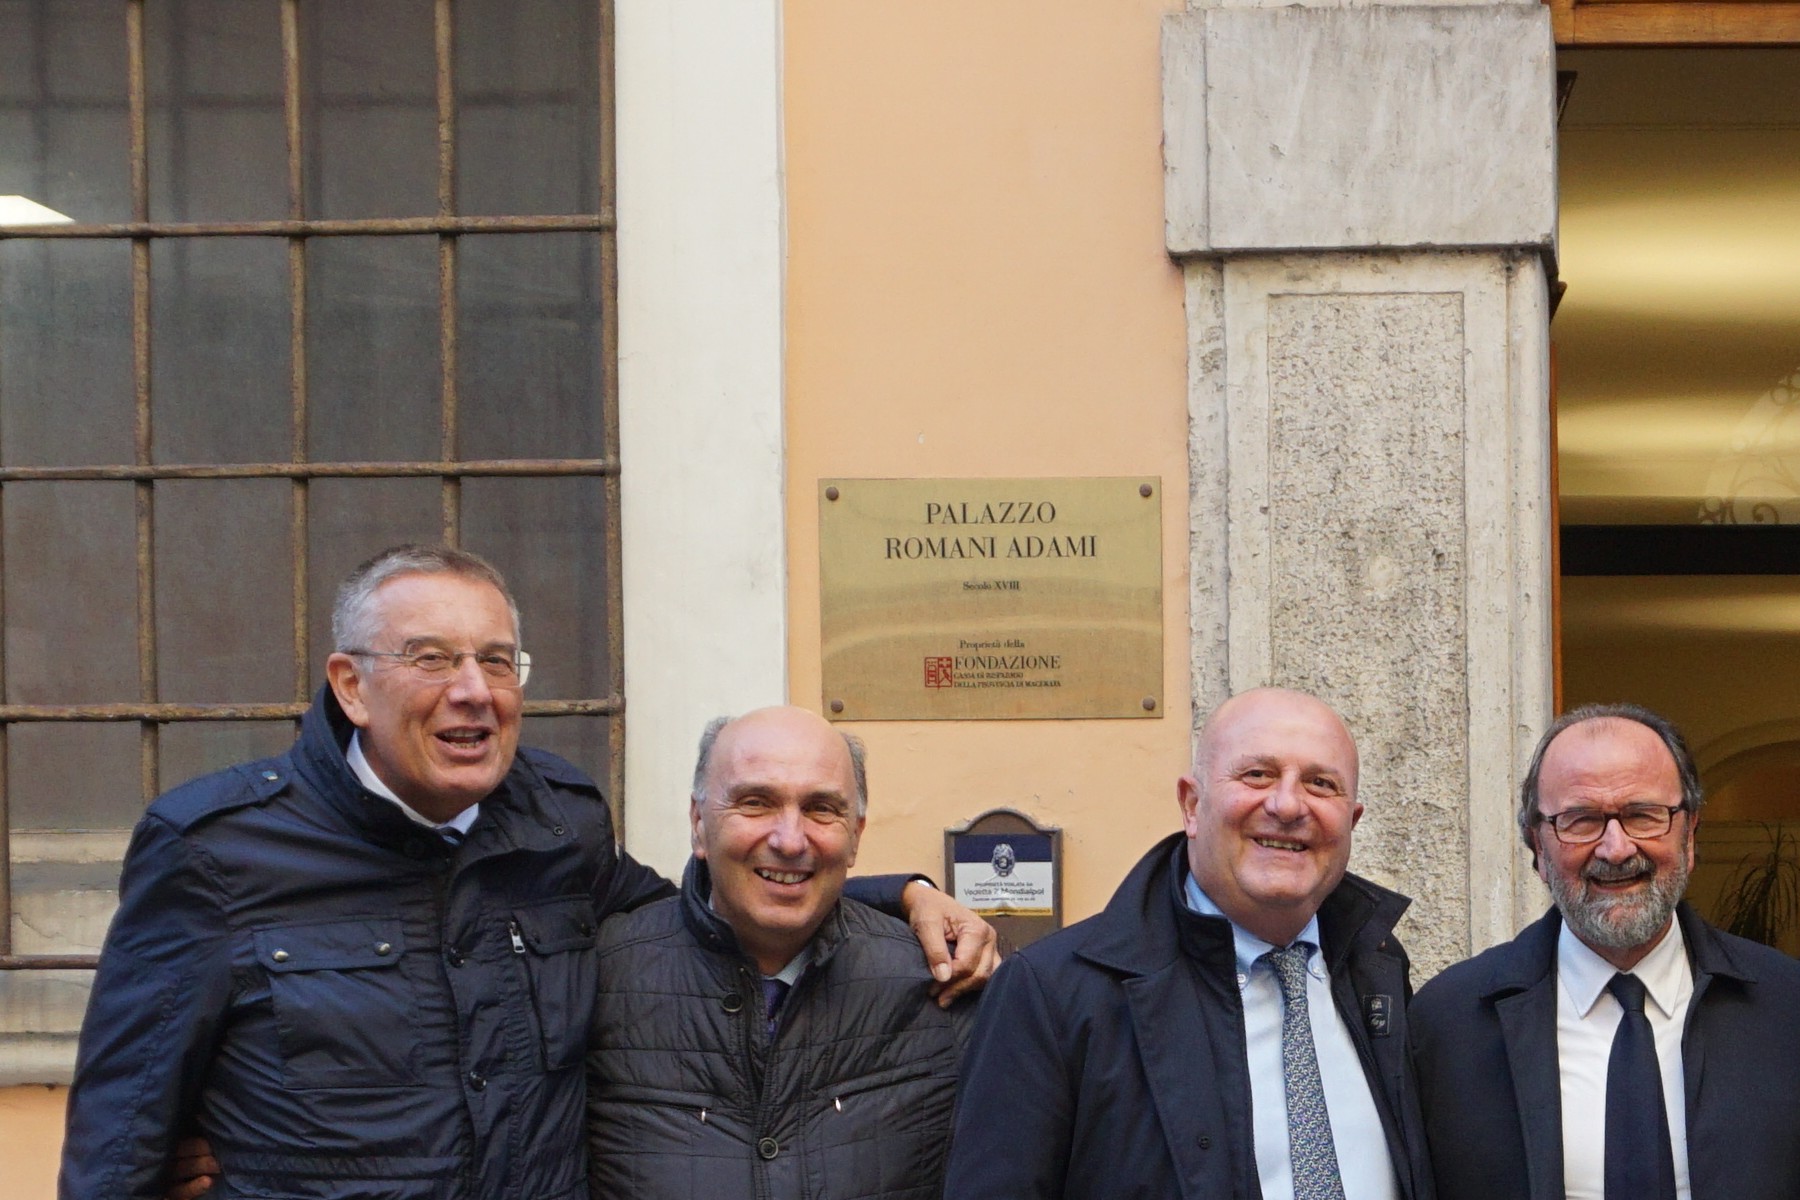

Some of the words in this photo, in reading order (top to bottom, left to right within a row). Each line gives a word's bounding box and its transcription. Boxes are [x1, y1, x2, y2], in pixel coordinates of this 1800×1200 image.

[925, 502, 1057, 525] PALAZZO
[884, 537, 997, 560] ROMANI
[1006, 535, 1097, 558] ADAMI
[963, 581, 992, 590] Secolo
[995, 580, 1020, 590] XVIII
[1004, 639, 1025, 648] della
[955, 656, 1061, 670] FONDAZIONE
